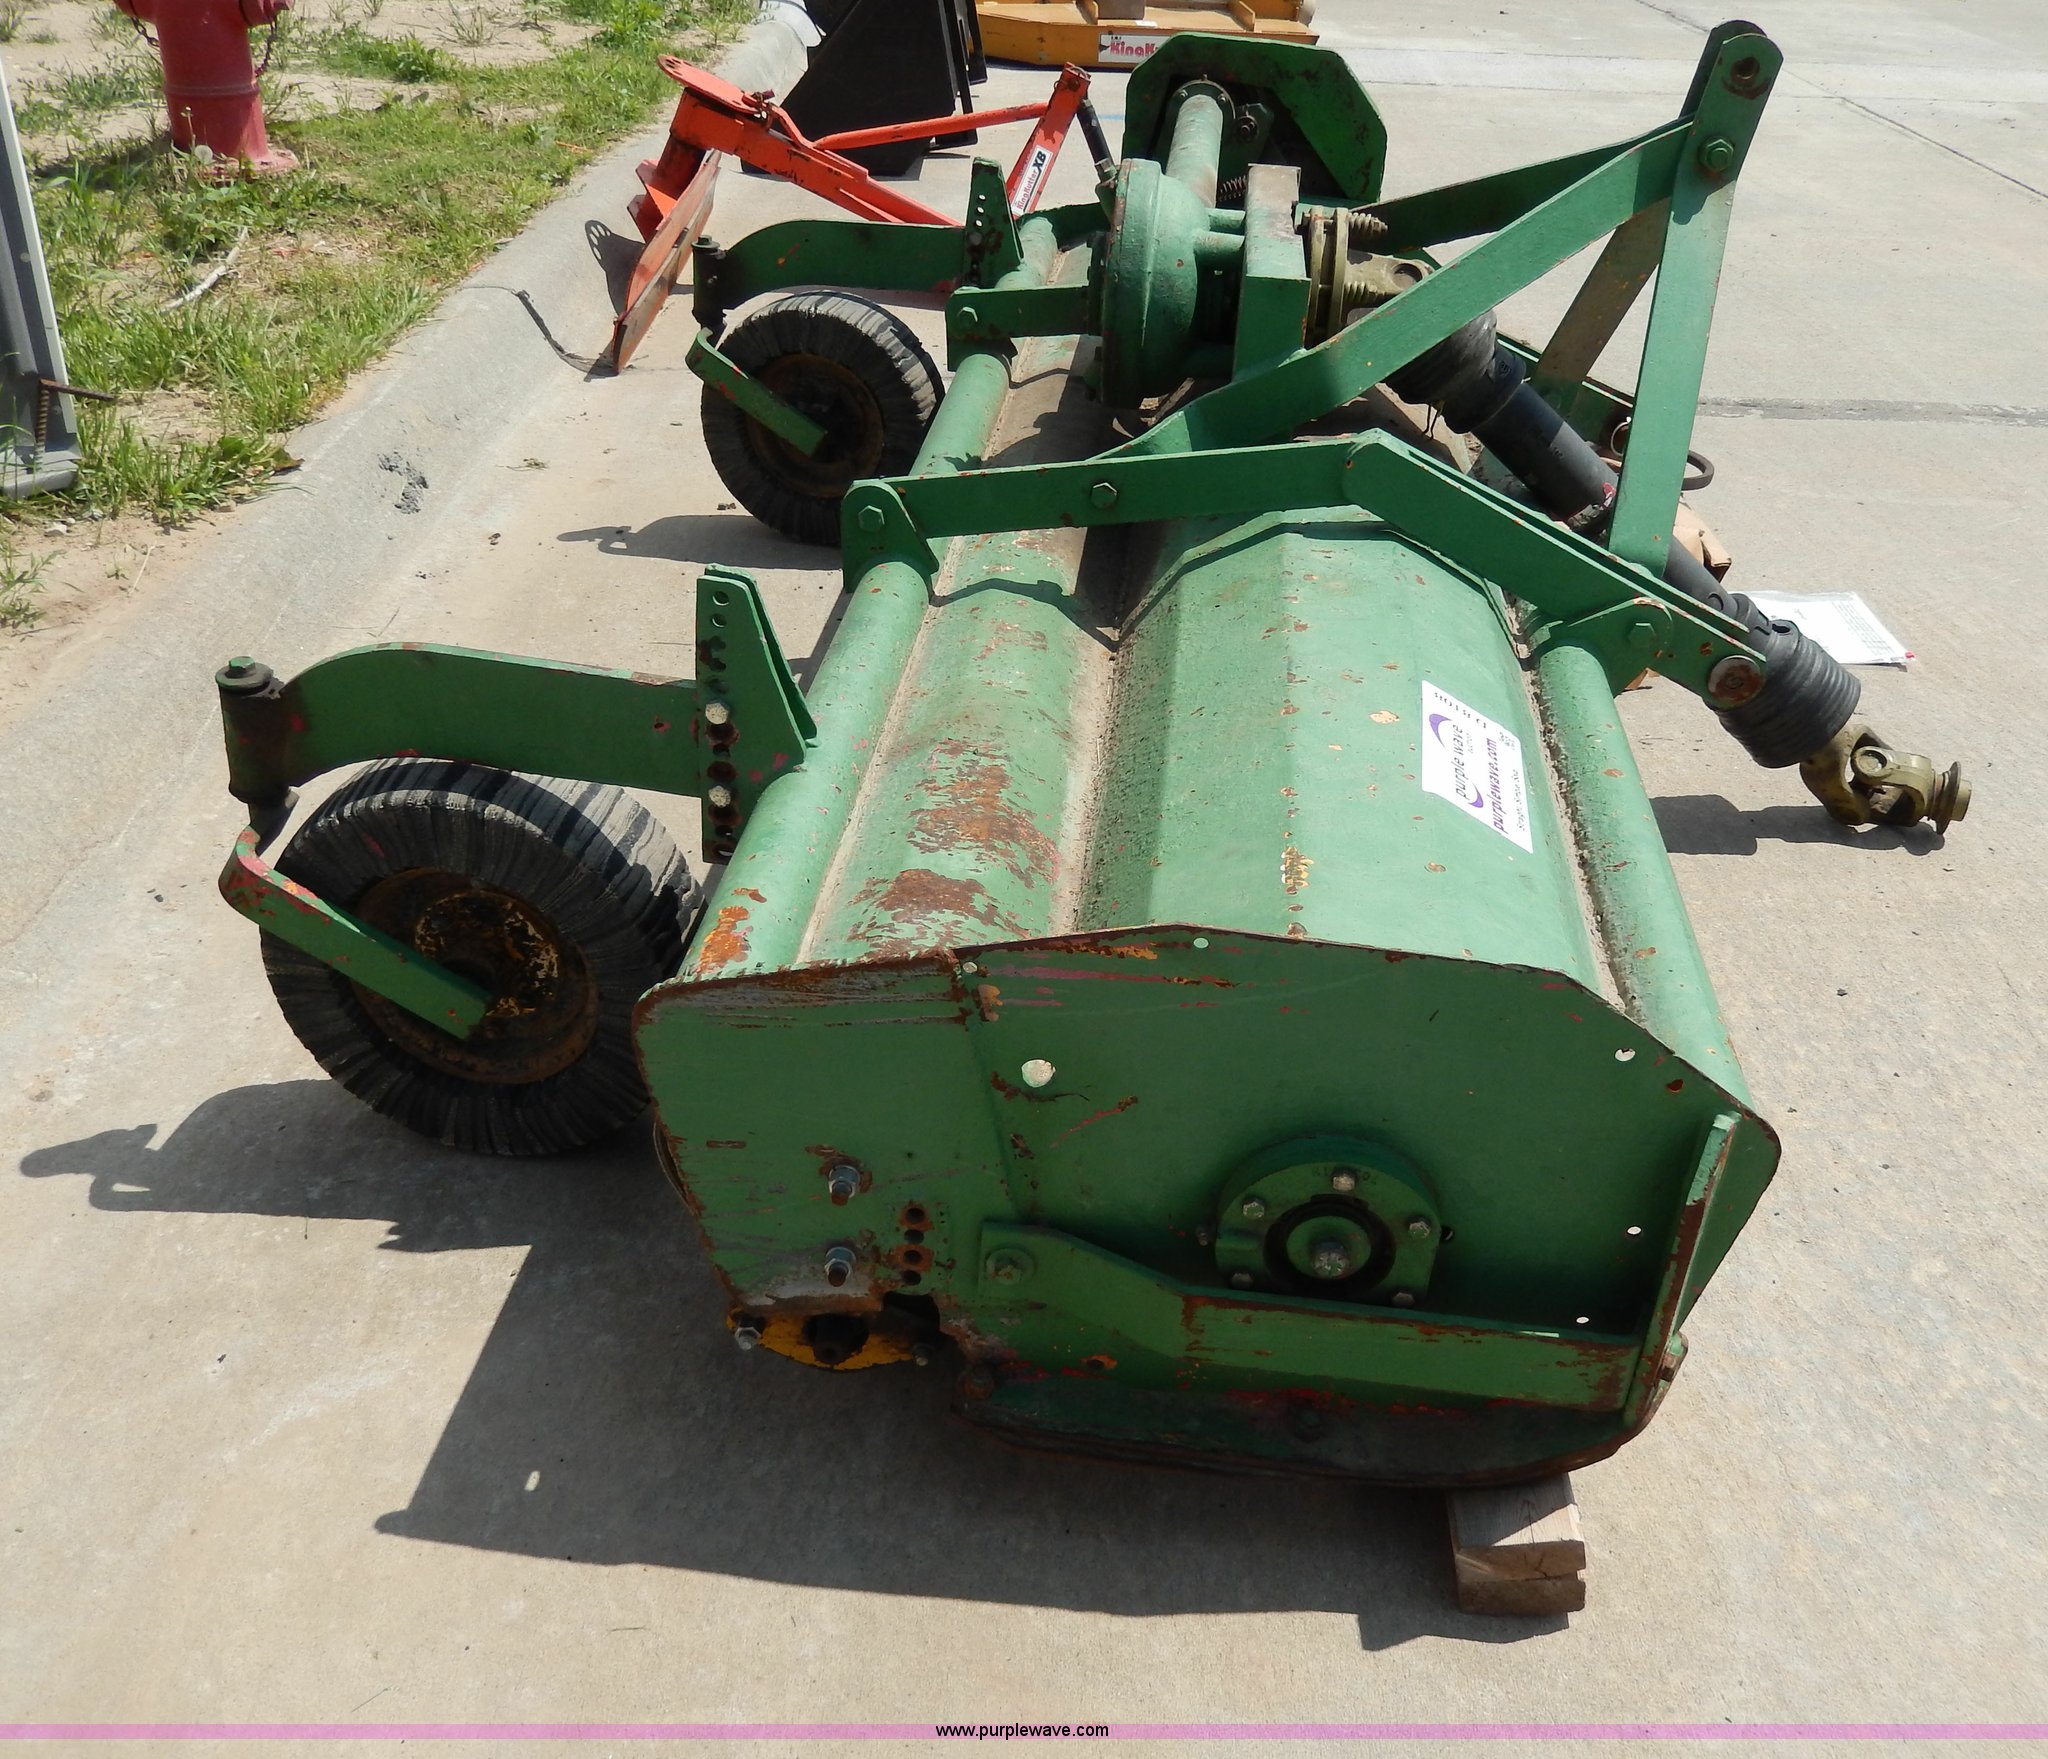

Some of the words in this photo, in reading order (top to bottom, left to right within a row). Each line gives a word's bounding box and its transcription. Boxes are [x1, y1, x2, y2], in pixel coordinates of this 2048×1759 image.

[1110, 41, 1159, 57] KingK
[1032, 150, 1047, 170] XB
[1452, 724, 1464, 756] wave
[1450, 756, 1471, 801] purple
[1486, 738, 1509, 835] purplewave.com
